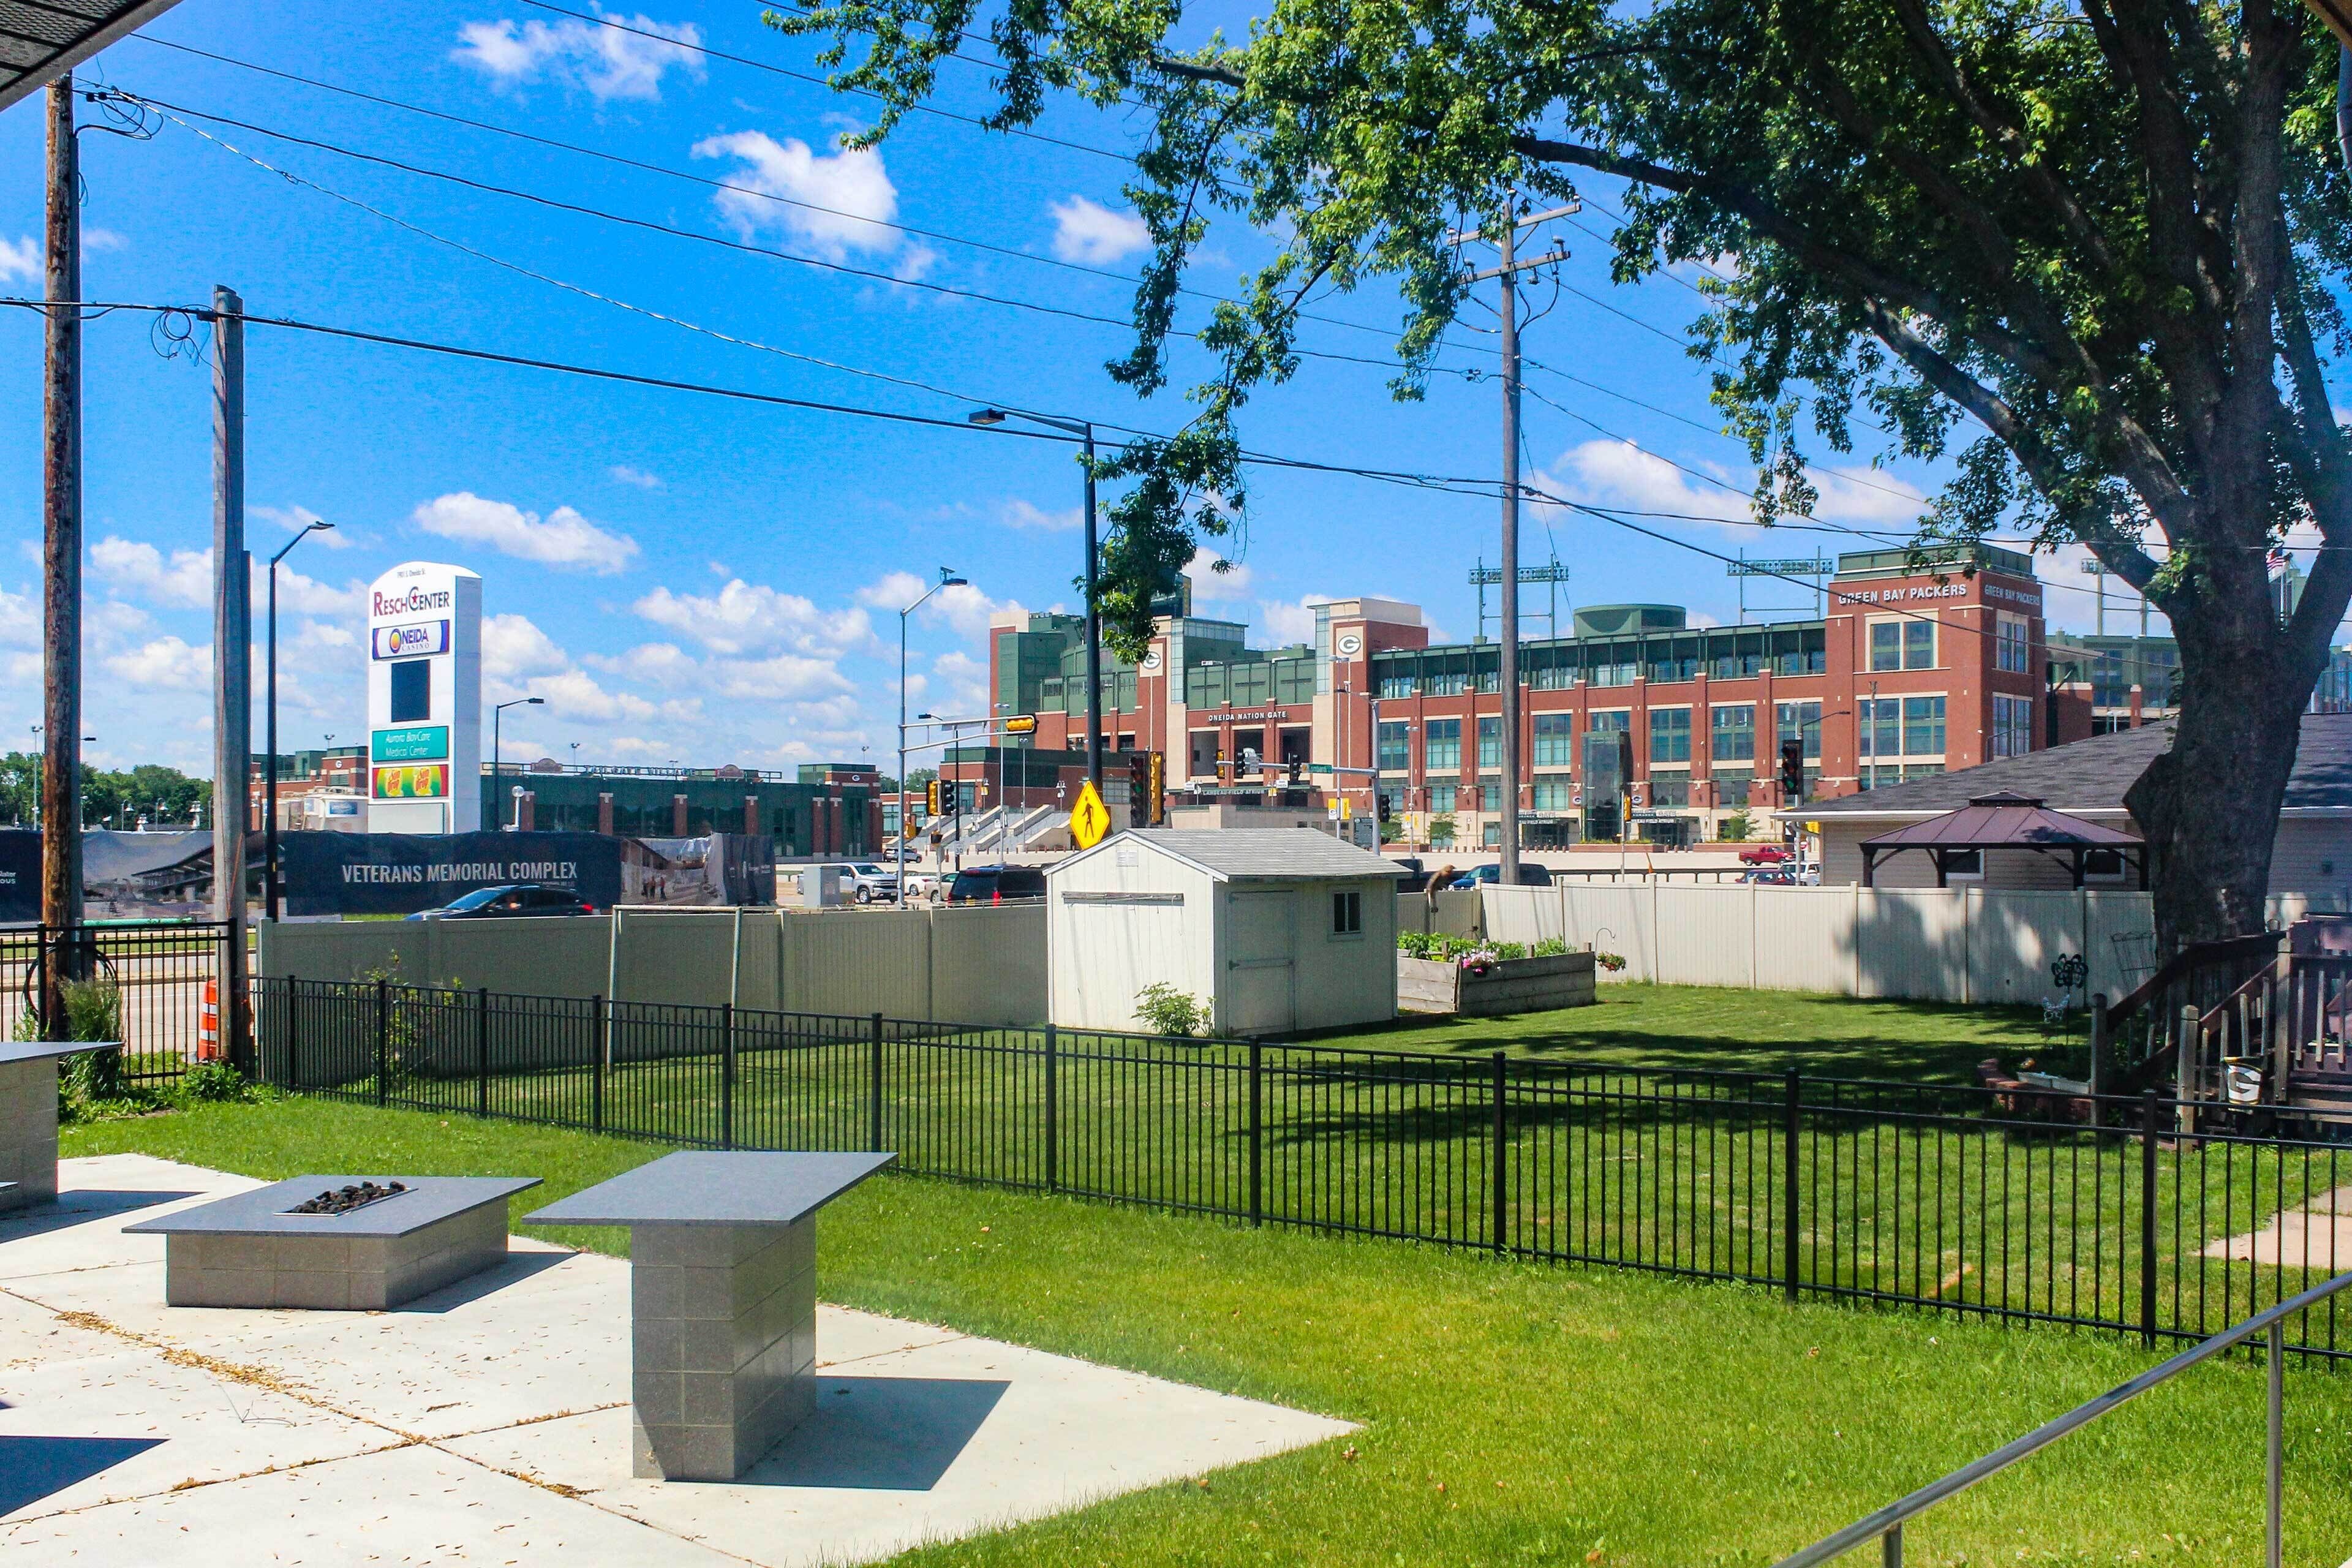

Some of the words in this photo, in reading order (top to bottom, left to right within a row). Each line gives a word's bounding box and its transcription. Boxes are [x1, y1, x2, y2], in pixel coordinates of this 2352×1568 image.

[1838, 590, 1879, 605] GREEN
[1883, 588, 1906, 601] BAY
[1910, 583, 1967, 599] PACKERS
[1985, 584, 2004, 598] GREEN
[2005, 589, 2015, 600] BAY
[2016, 591, 2040, 606] PACKERS
[389, 628, 429, 654] ONEIDA
[402, 643, 430, 652] CASINO
[1338, 635, 1361, 654] G
[410, 745, 429, 756] Center
[647, 767, 696, 776] VILLAGE
[342, 864, 422, 883] VETERANS
[428, 862, 505, 881] MEMORIAL
[510, 862, 578, 880] COMPLEX
